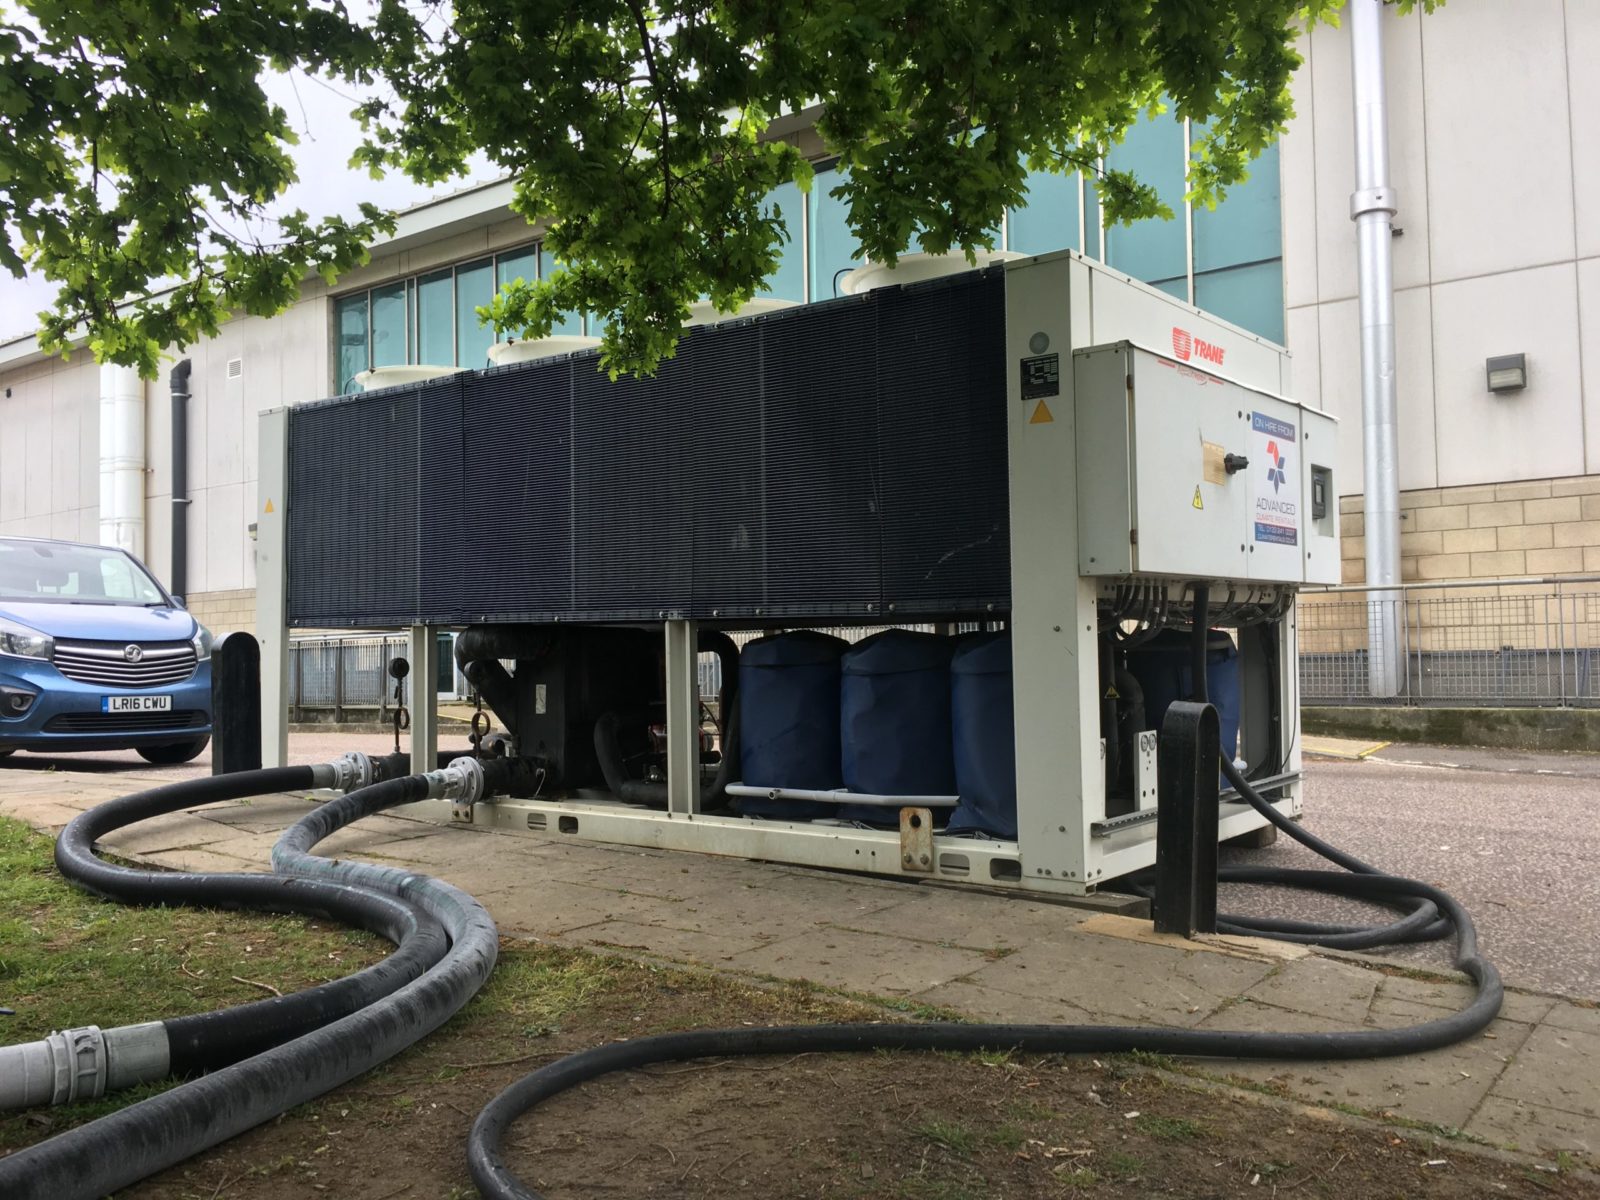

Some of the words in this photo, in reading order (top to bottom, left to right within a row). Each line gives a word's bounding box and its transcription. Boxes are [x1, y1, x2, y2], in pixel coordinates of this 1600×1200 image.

[1194, 337, 1225, 366] TRANE
[1254, 417, 1264, 428] ON
[1265, 420, 1277, 432] HIRE
[1277, 425, 1294, 437] FROM
[1256, 497, 1296, 516] ADVANCED
[113, 698, 140, 710] LR16
[143, 697, 167, 709] CWU
